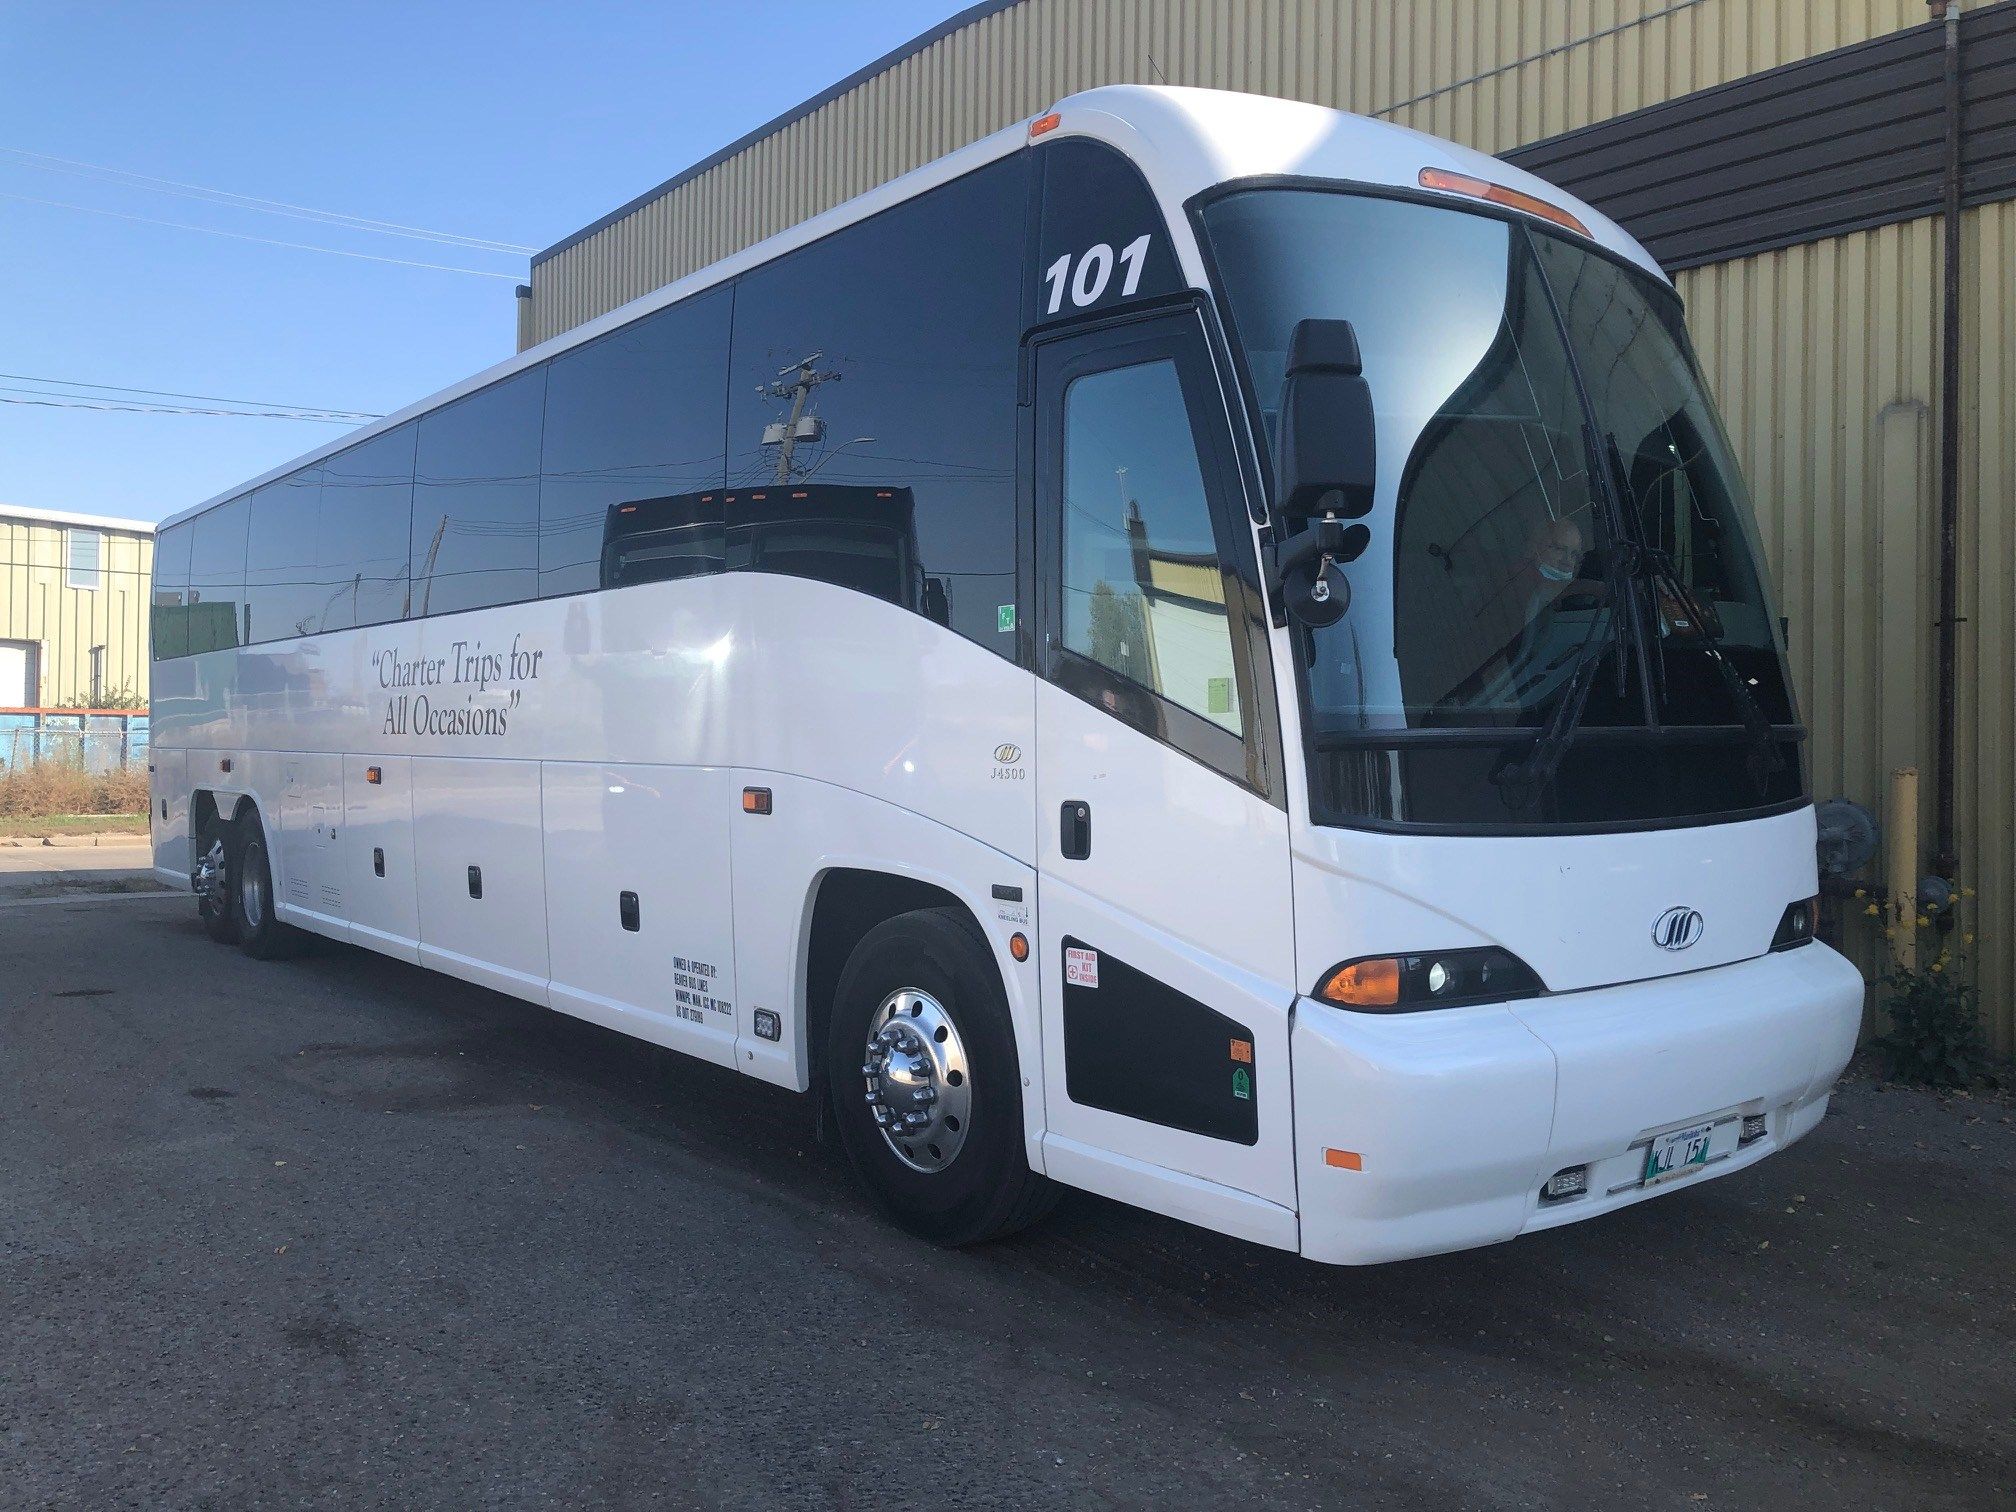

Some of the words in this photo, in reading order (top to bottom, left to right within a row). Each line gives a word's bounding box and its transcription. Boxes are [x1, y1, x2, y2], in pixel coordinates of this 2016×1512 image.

[1046, 233, 1151, 315] 101
[451, 640, 503, 692] Trips
[508, 633, 543, 681] for
[383, 694, 407, 735] All
[991, 767, 1026, 780] J4500
[998, 914, 1019, 923] KNEELING
[1019, 917, 1028, 925] BUS
[1067, 950, 1085, 960] FIRST
[1085, 952, 1096, 961] AID
[691, 960, 710, 977] OPERATED
[1081, 962, 1092, 973] KIT
[688, 976, 697, 990] BUS
[697, 978, 708, 993] LINES
[1079, 973, 1097, 984] INSIDE
[1652, 1146, 1675, 1175] KJL
